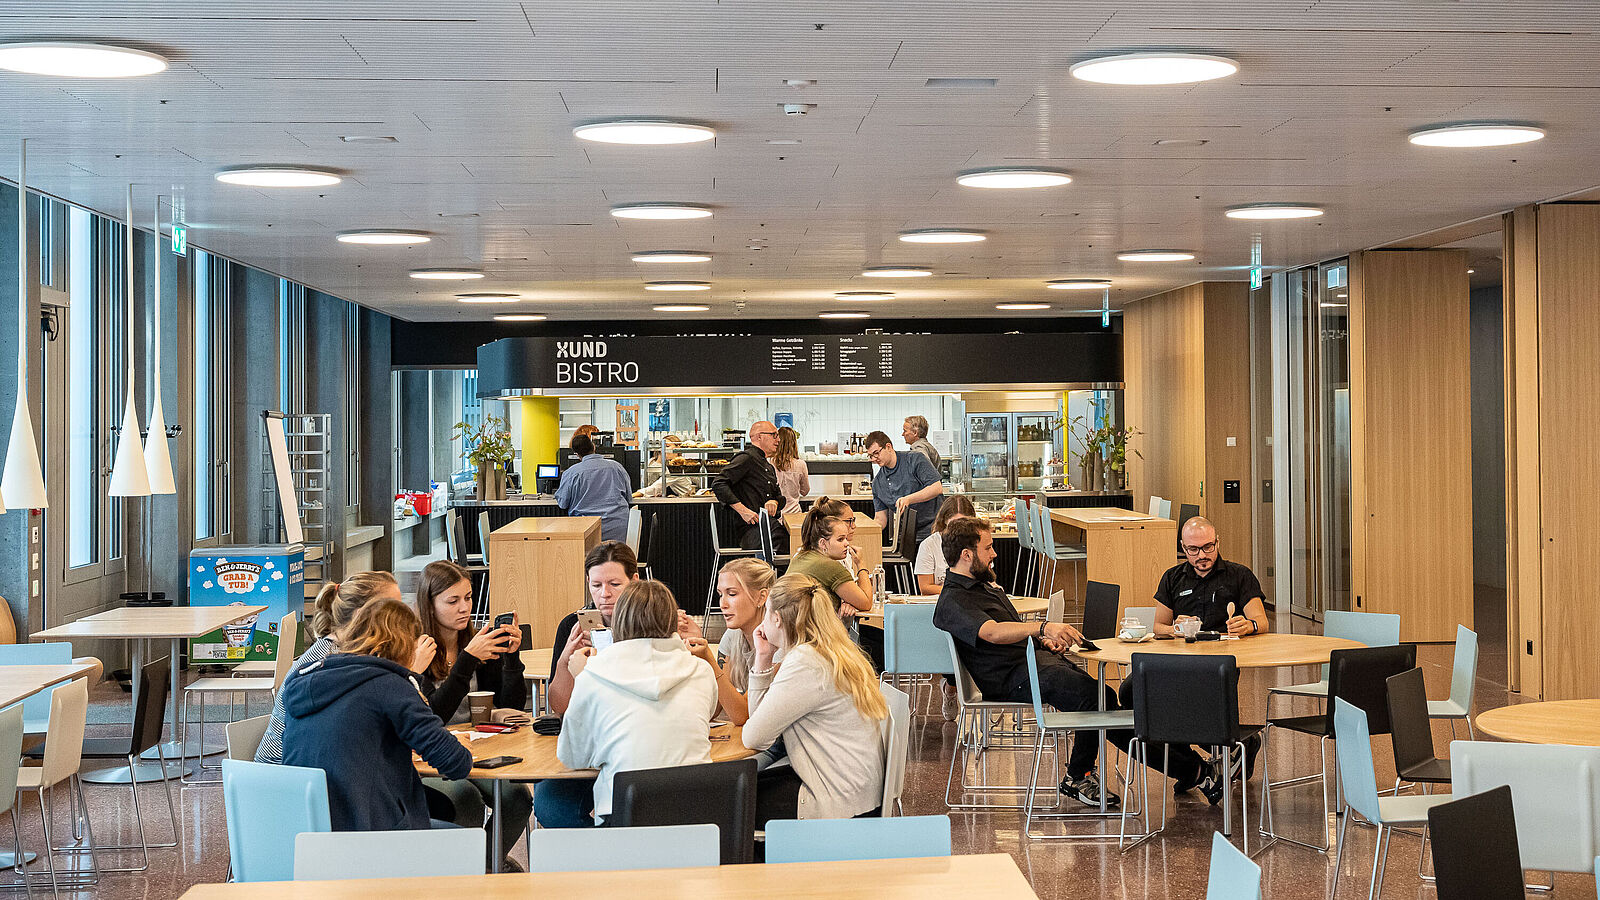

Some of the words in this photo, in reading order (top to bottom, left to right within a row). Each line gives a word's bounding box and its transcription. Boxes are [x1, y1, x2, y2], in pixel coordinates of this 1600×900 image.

[556, 341, 608, 358] XUND
[556, 361, 639, 383] BISTRO
[223, 573, 246, 581] GRAB
[247, 573, 254, 581] A
[228, 581, 249, 589] TUB!
